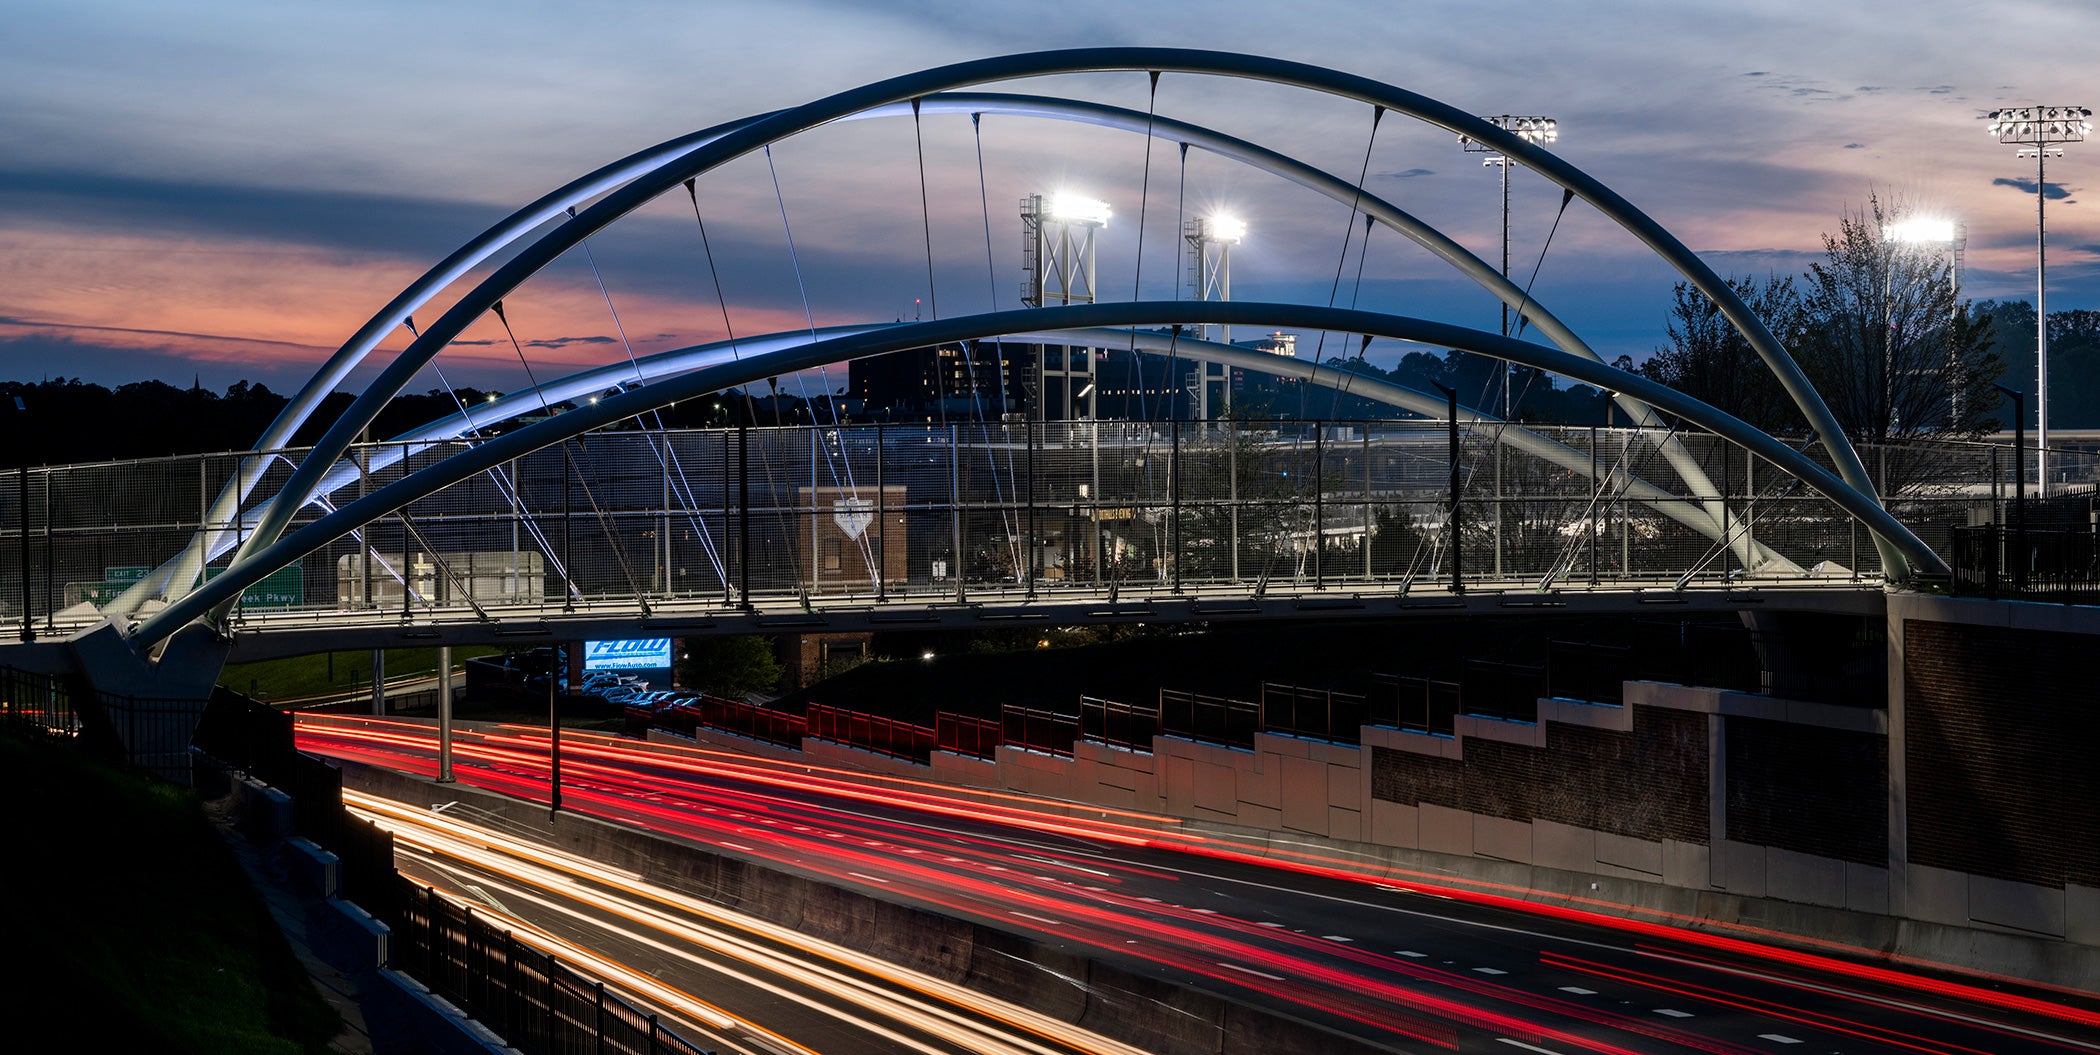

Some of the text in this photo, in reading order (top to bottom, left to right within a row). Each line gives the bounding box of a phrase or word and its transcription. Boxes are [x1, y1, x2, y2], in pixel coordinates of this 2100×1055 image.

[90, 589, 99, 598] W
[266, 593, 296, 604] Pkwy
[592, 638, 670, 653] FLOW
